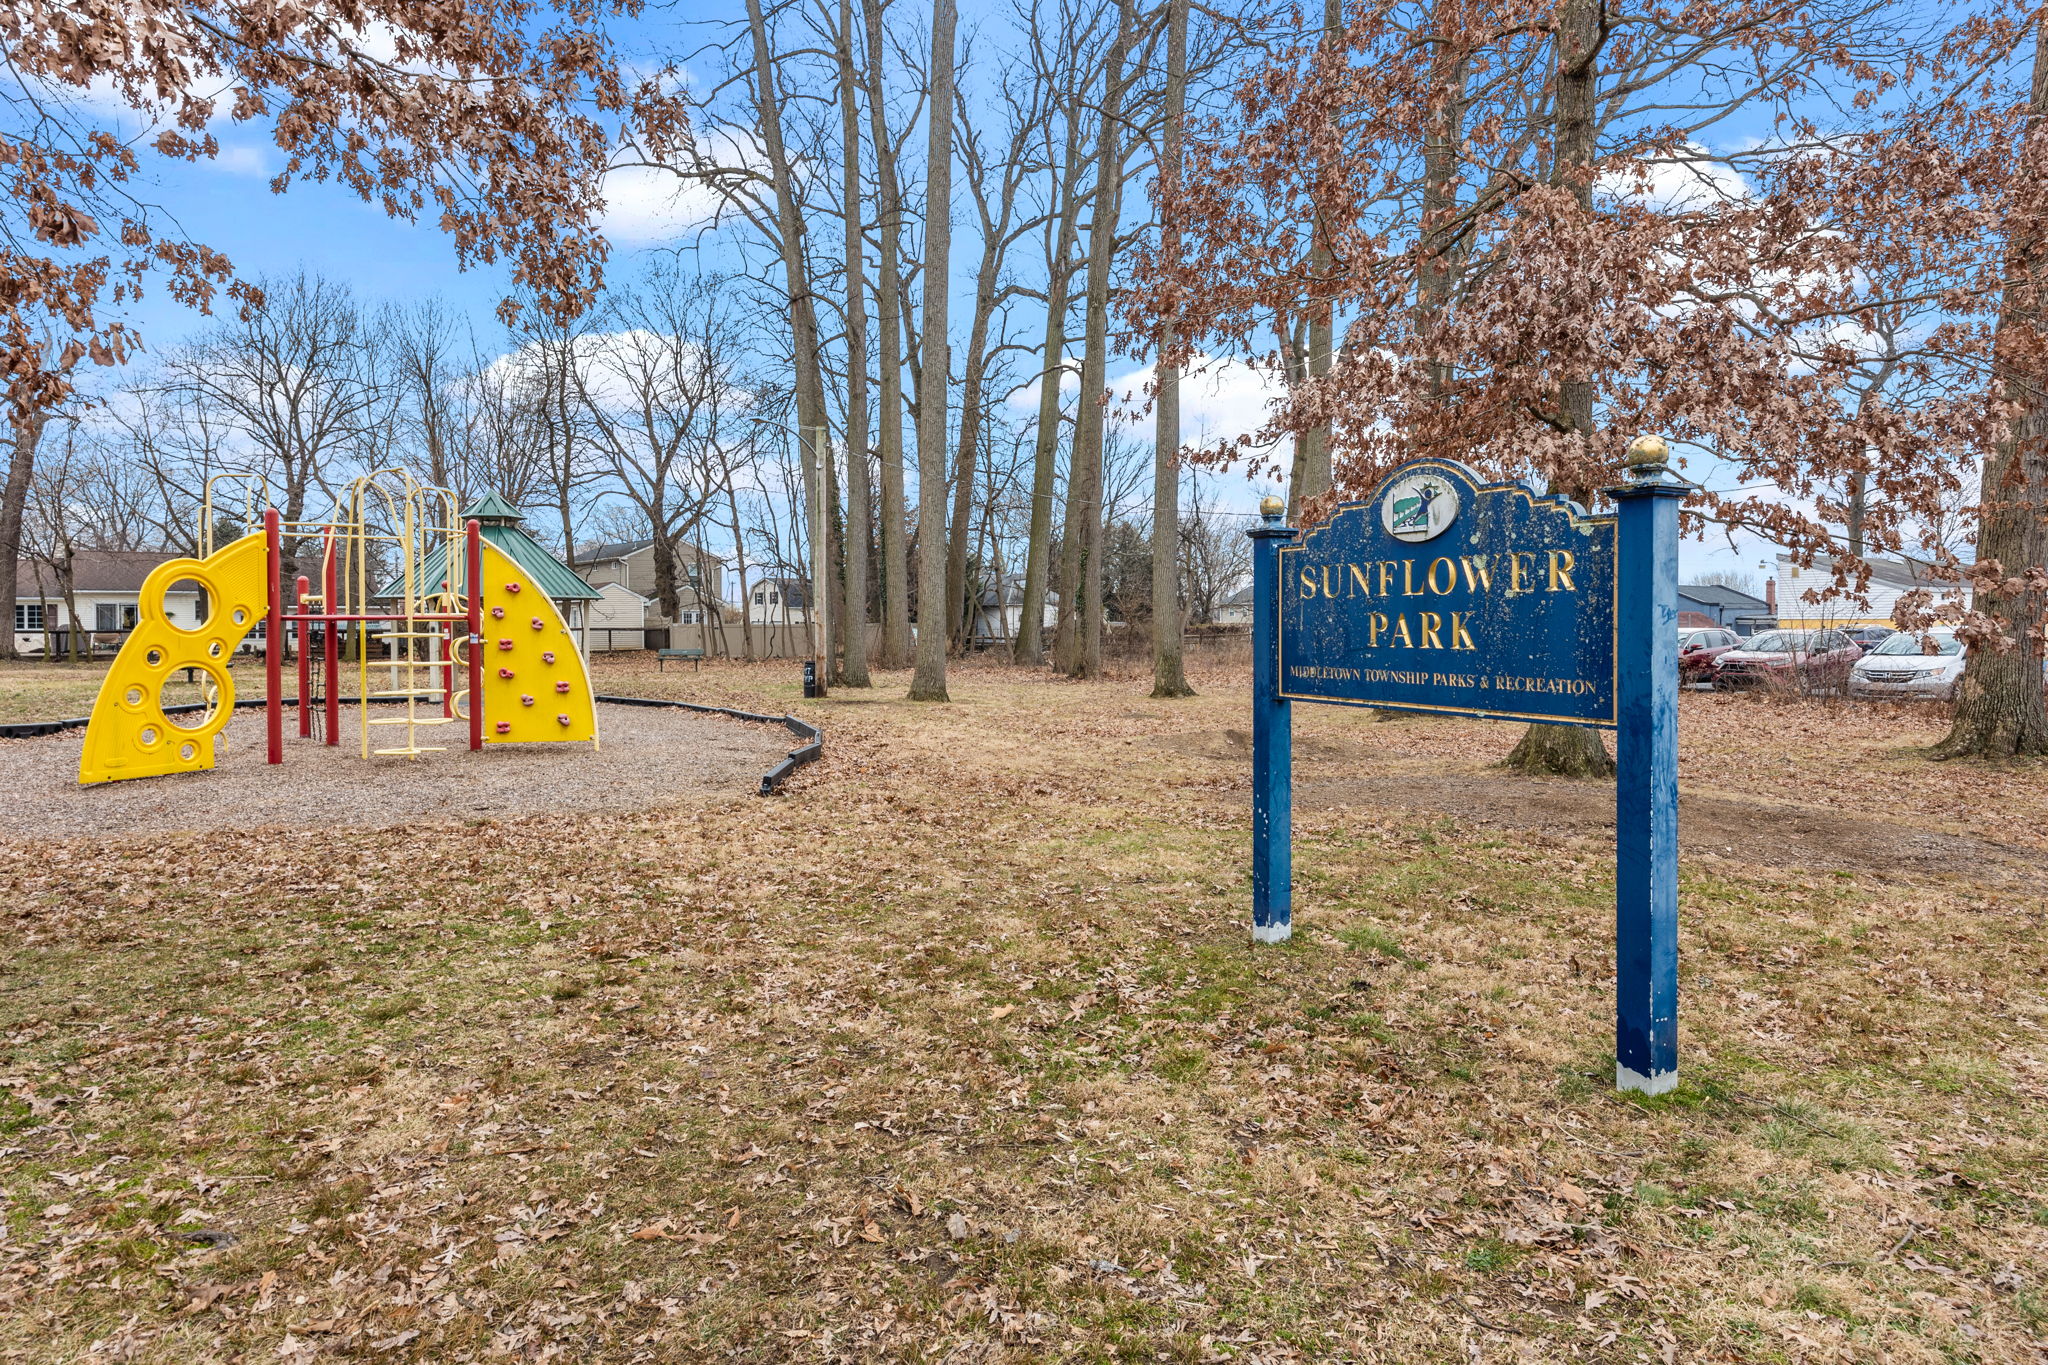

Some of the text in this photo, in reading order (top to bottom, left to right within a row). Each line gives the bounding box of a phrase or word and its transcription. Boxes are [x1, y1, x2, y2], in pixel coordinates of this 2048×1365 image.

[1300, 550, 1577, 599] SUNFLOWER
[1367, 610, 1478, 650] PARK
[1290, 665, 1597, 695] MIDDLETOWN TOWNSHIP PARKS & RECREATION
